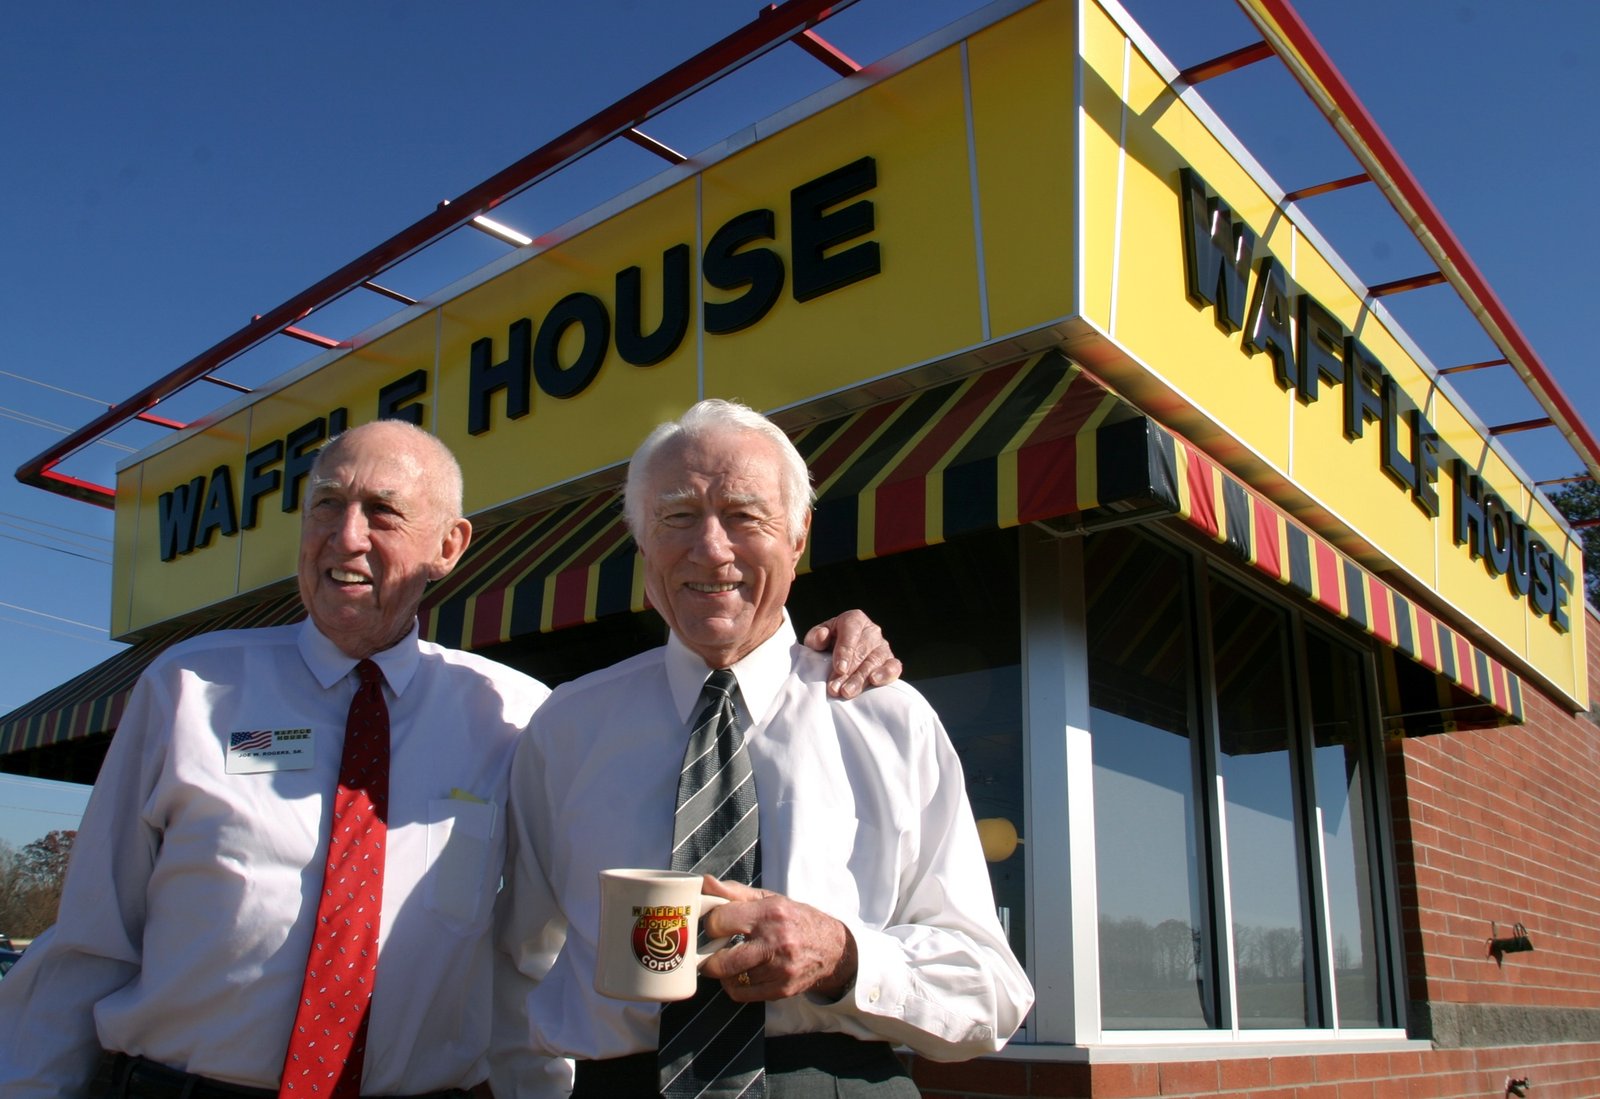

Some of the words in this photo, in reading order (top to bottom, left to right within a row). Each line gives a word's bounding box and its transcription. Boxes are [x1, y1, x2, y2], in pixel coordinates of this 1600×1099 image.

[158, 369, 428, 562] WAFFE
[468, 155, 881, 436] HOUSE
[1178, 167, 1440, 519] WAFFLE
[1453, 458, 1575, 634] HOUSE
[632, 906, 691, 916] WAFFLE
[638, 919, 687, 928] HOUSE
[641, 953, 683, 971] COFFEE
